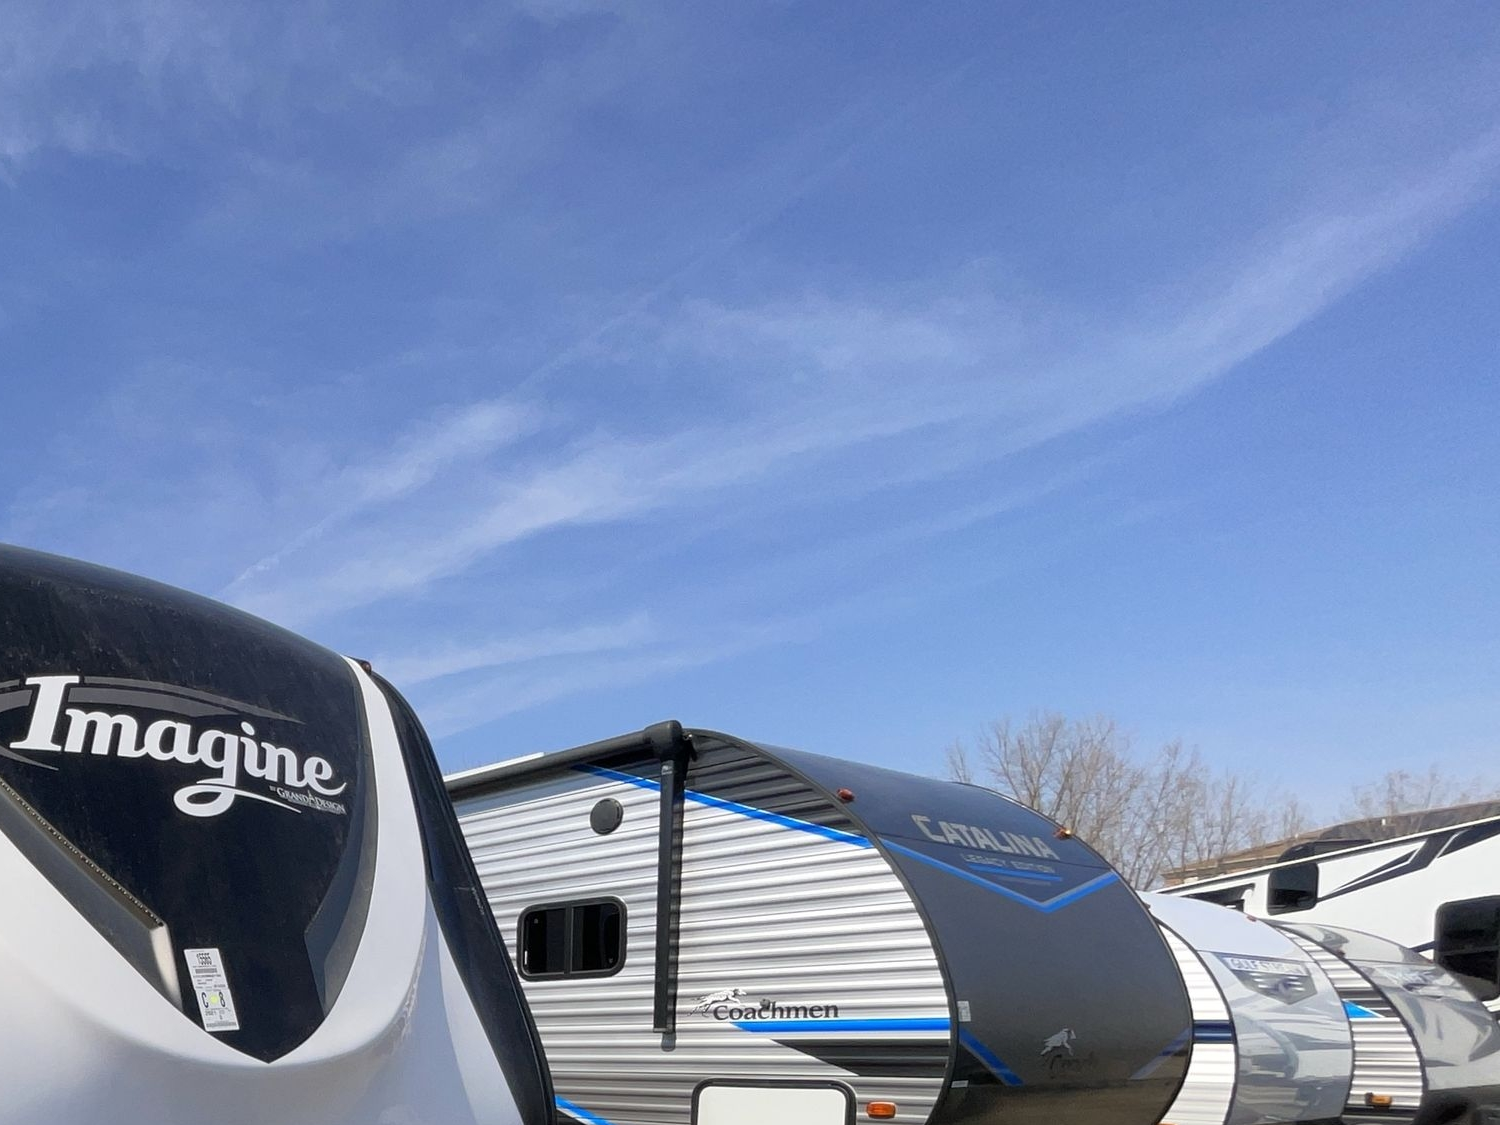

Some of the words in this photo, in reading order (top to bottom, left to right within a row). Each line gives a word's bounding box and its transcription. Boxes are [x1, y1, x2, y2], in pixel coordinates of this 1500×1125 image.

[10, 675, 346, 817] Imagine
[911, 814, 1060, 860] CATALINA
[713, 1001, 839, 1020] Coachmen
